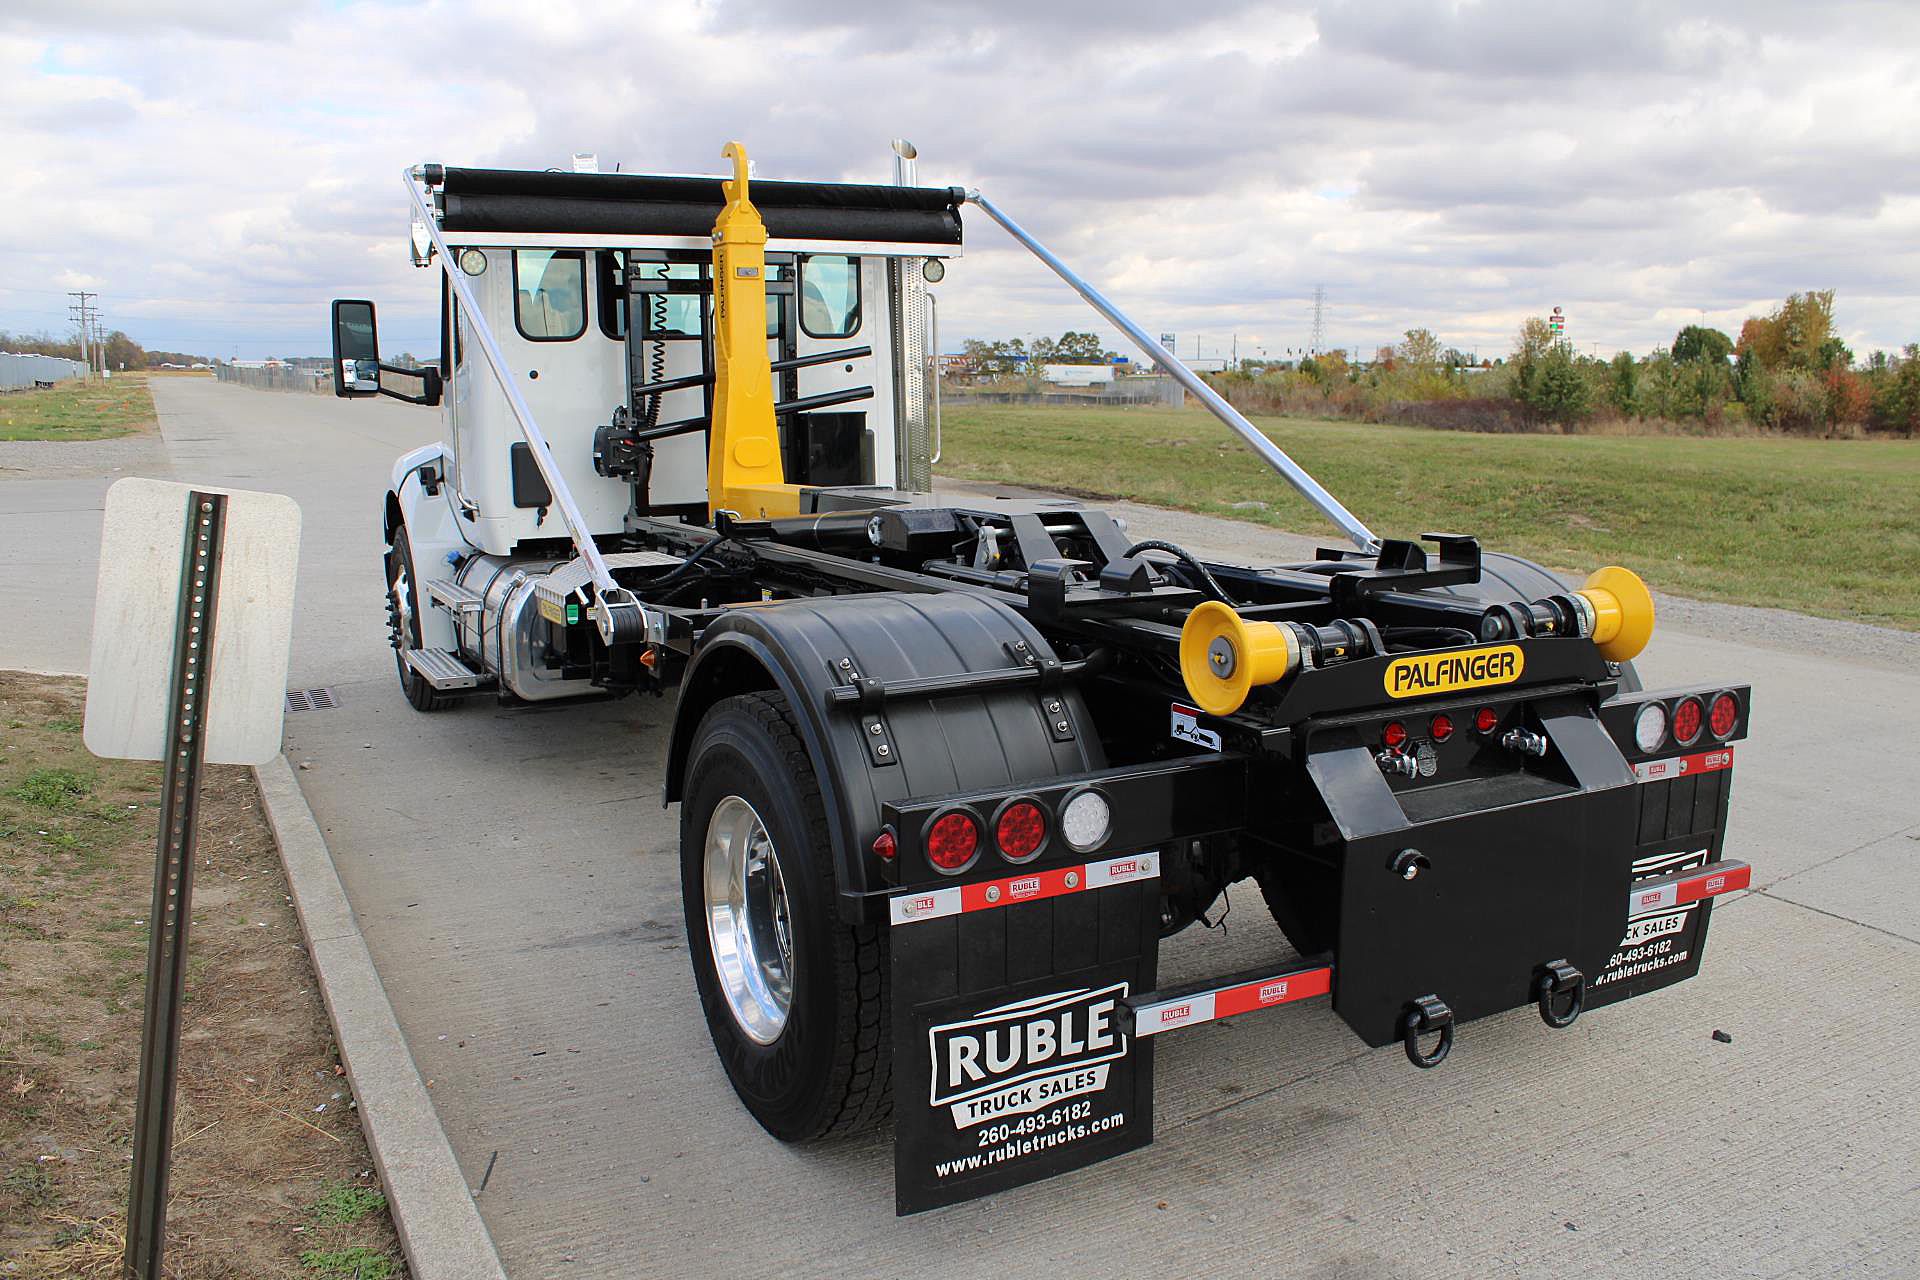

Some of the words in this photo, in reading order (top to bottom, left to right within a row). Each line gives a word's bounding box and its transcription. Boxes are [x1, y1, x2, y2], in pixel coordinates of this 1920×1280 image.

[1394, 652, 1515, 692] PALFINGER
[1111, 863, 1136, 875] RUBLE
[1012, 881, 1038, 892] RUBLE
[1643, 916, 1679, 936] SALES
[1587, 950, 1688, 988] w.rubletrucks.com
[1604, 939, 1672, 969] 60-493-6182
[1262, 985, 1286, 997] RUBLE
[1163, 1007, 1190, 1021] RUBLE
[949, 999, 1115, 1088] RUBLE
[967, 1088, 1033, 1119] TRUCK
[1039, 1070, 1096, 1099] SALES
[977, 1100, 1092, 1148] 260-493-6182
[935, 1112, 1124, 1178] www.rubletrucks.com
